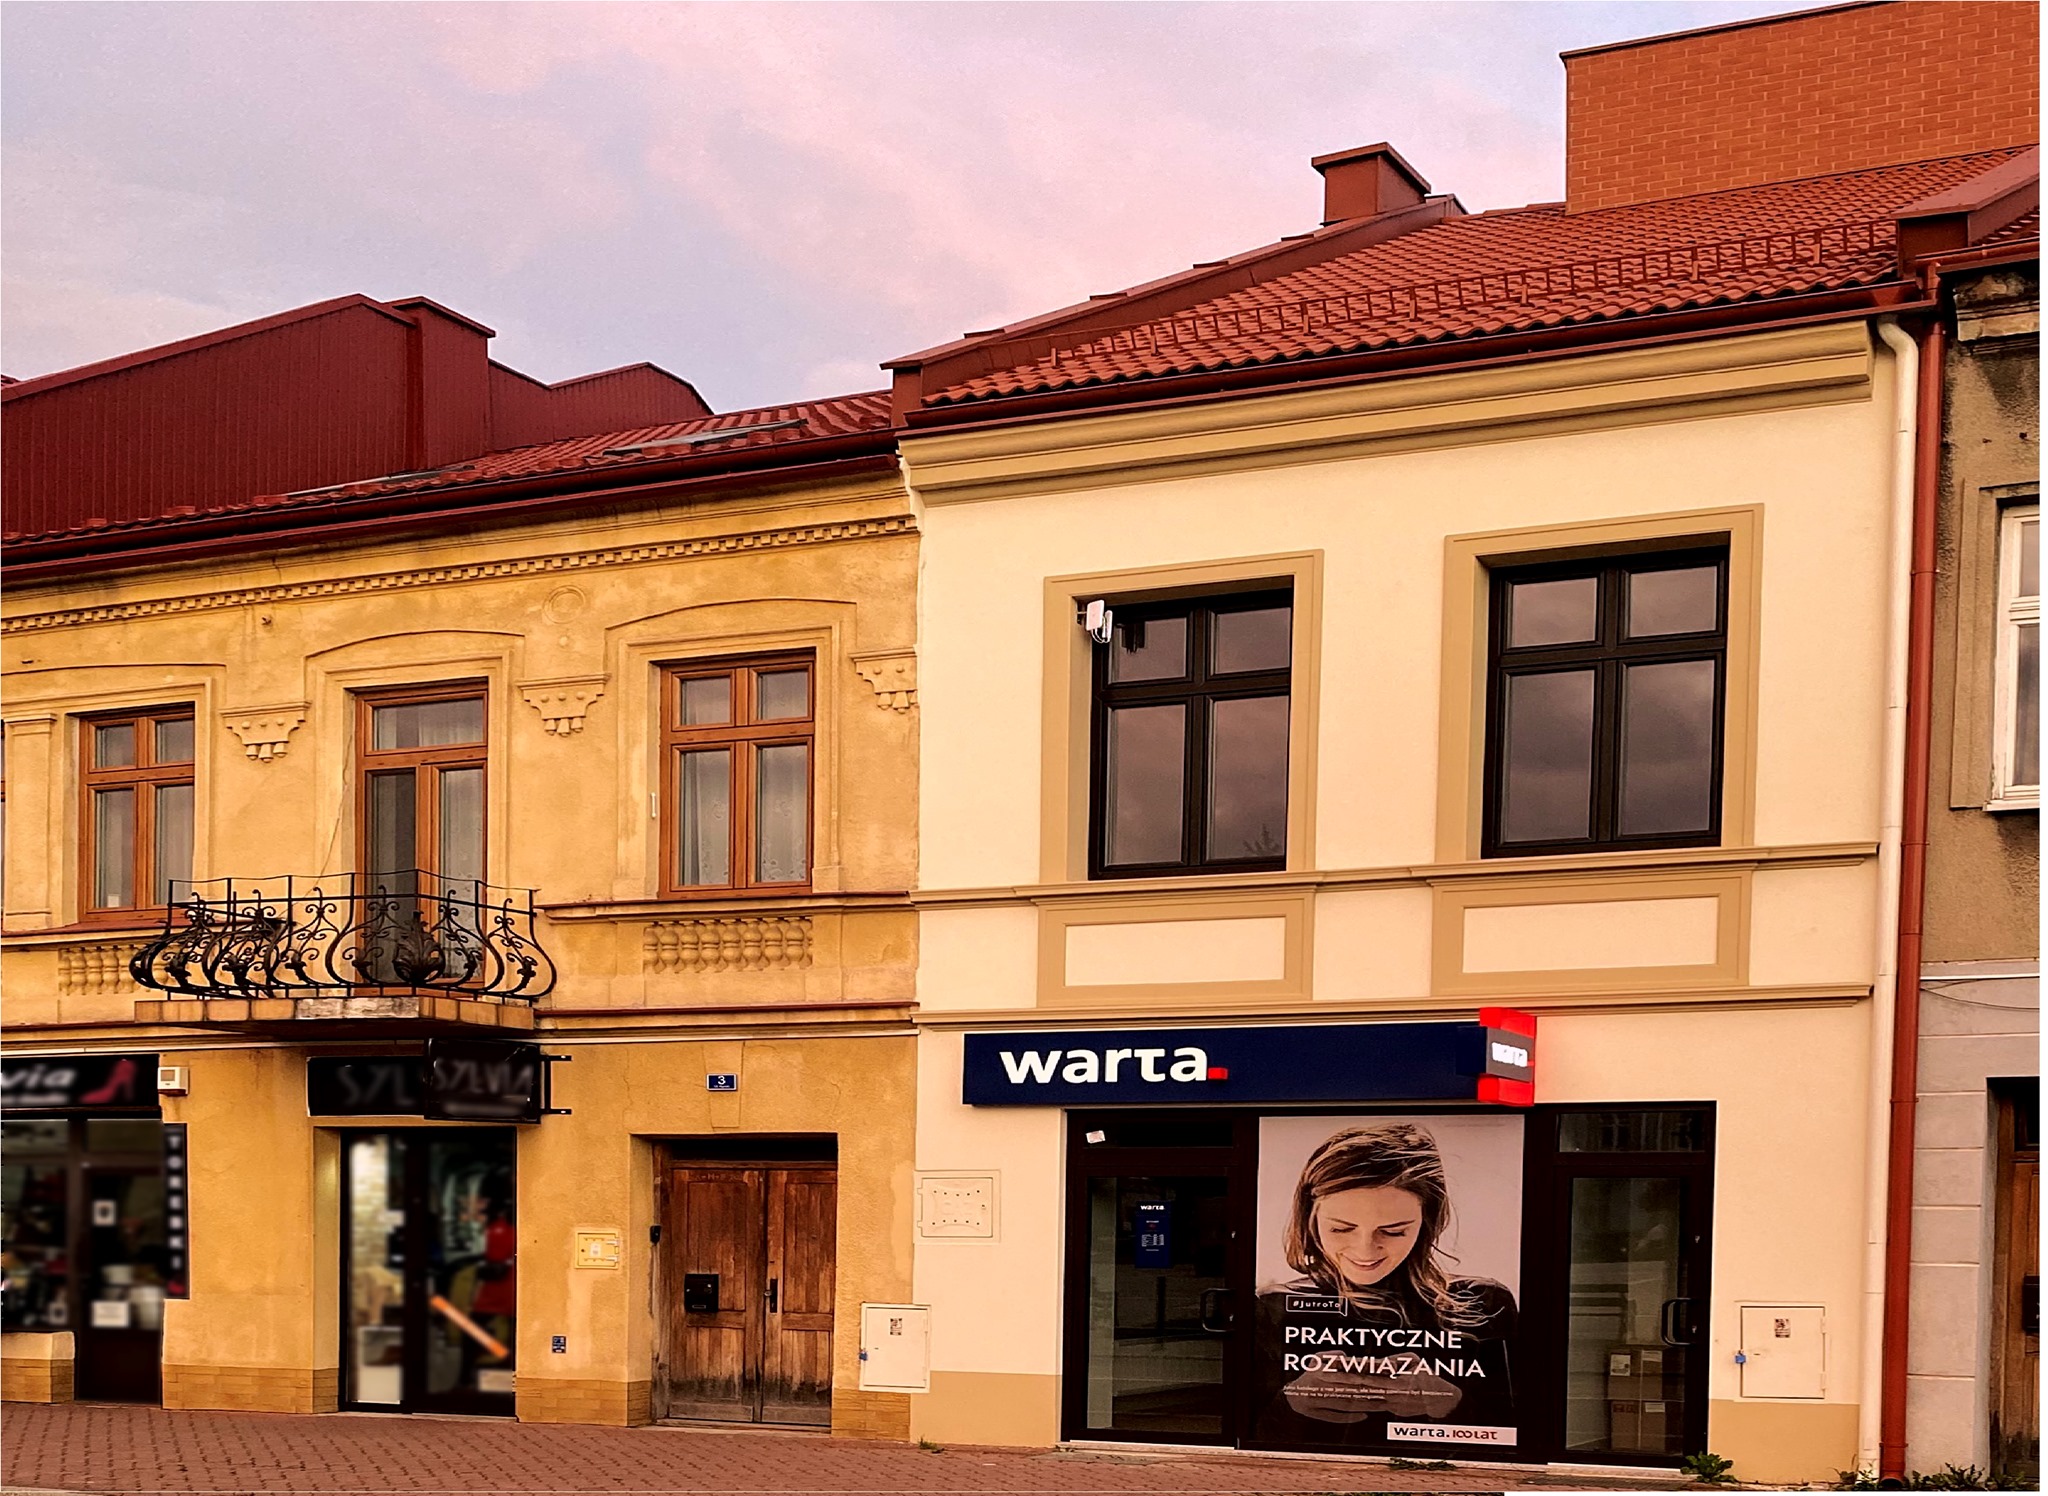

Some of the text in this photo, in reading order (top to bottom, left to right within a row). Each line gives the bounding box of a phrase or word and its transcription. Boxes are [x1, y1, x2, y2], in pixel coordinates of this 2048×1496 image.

[337, 1065, 418, 1107] SYL
[717, 1075, 726, 1085] 3
[1293, 1300, 1341, 1309] #JutroTo
[1284, 1326, 1462, 1349] PRAKTYCZNE
[1283, 1353, 1486, 1379] ROZWIĄZANIA
